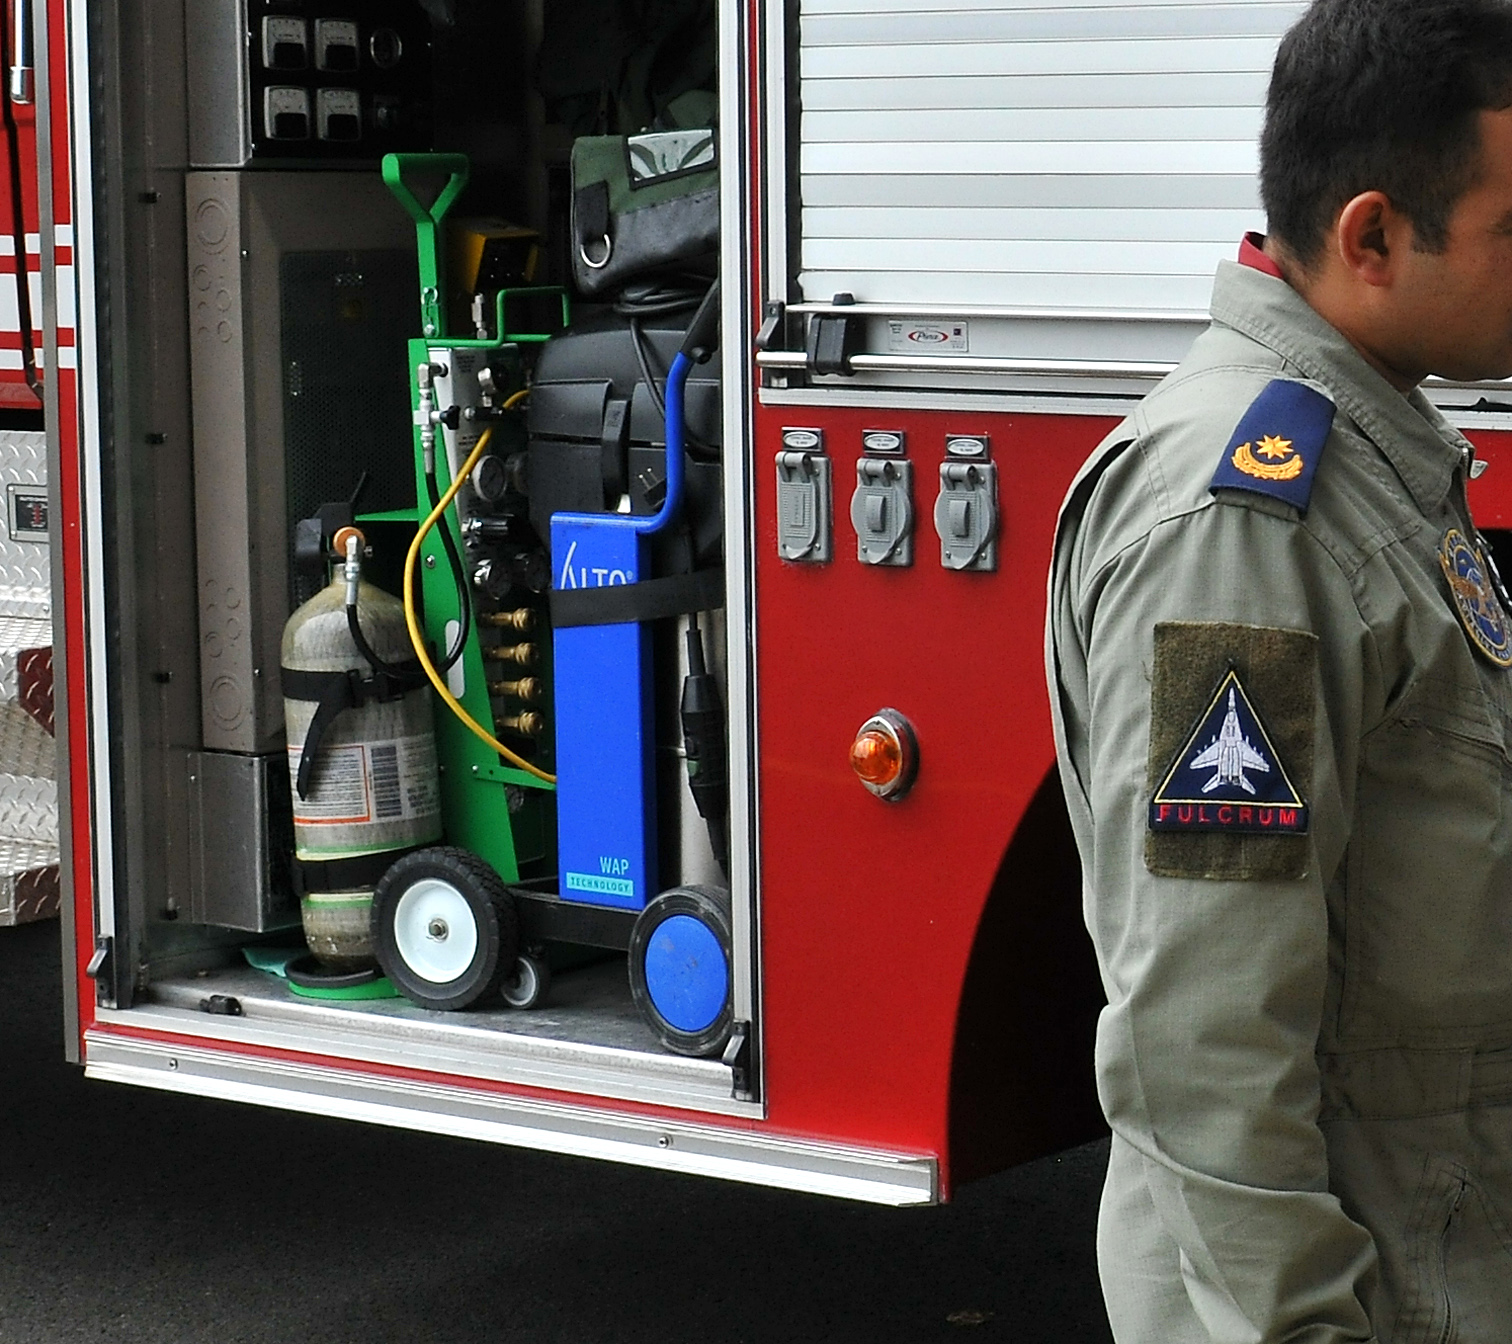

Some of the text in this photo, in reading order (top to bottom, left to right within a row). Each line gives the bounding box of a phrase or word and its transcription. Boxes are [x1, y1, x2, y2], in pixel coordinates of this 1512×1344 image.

[1155, 804, 1298, 827] FULCRUM
[599, 856, 629, 875] WAP
[570, 876, 630, 893] TECHNOLOGY
